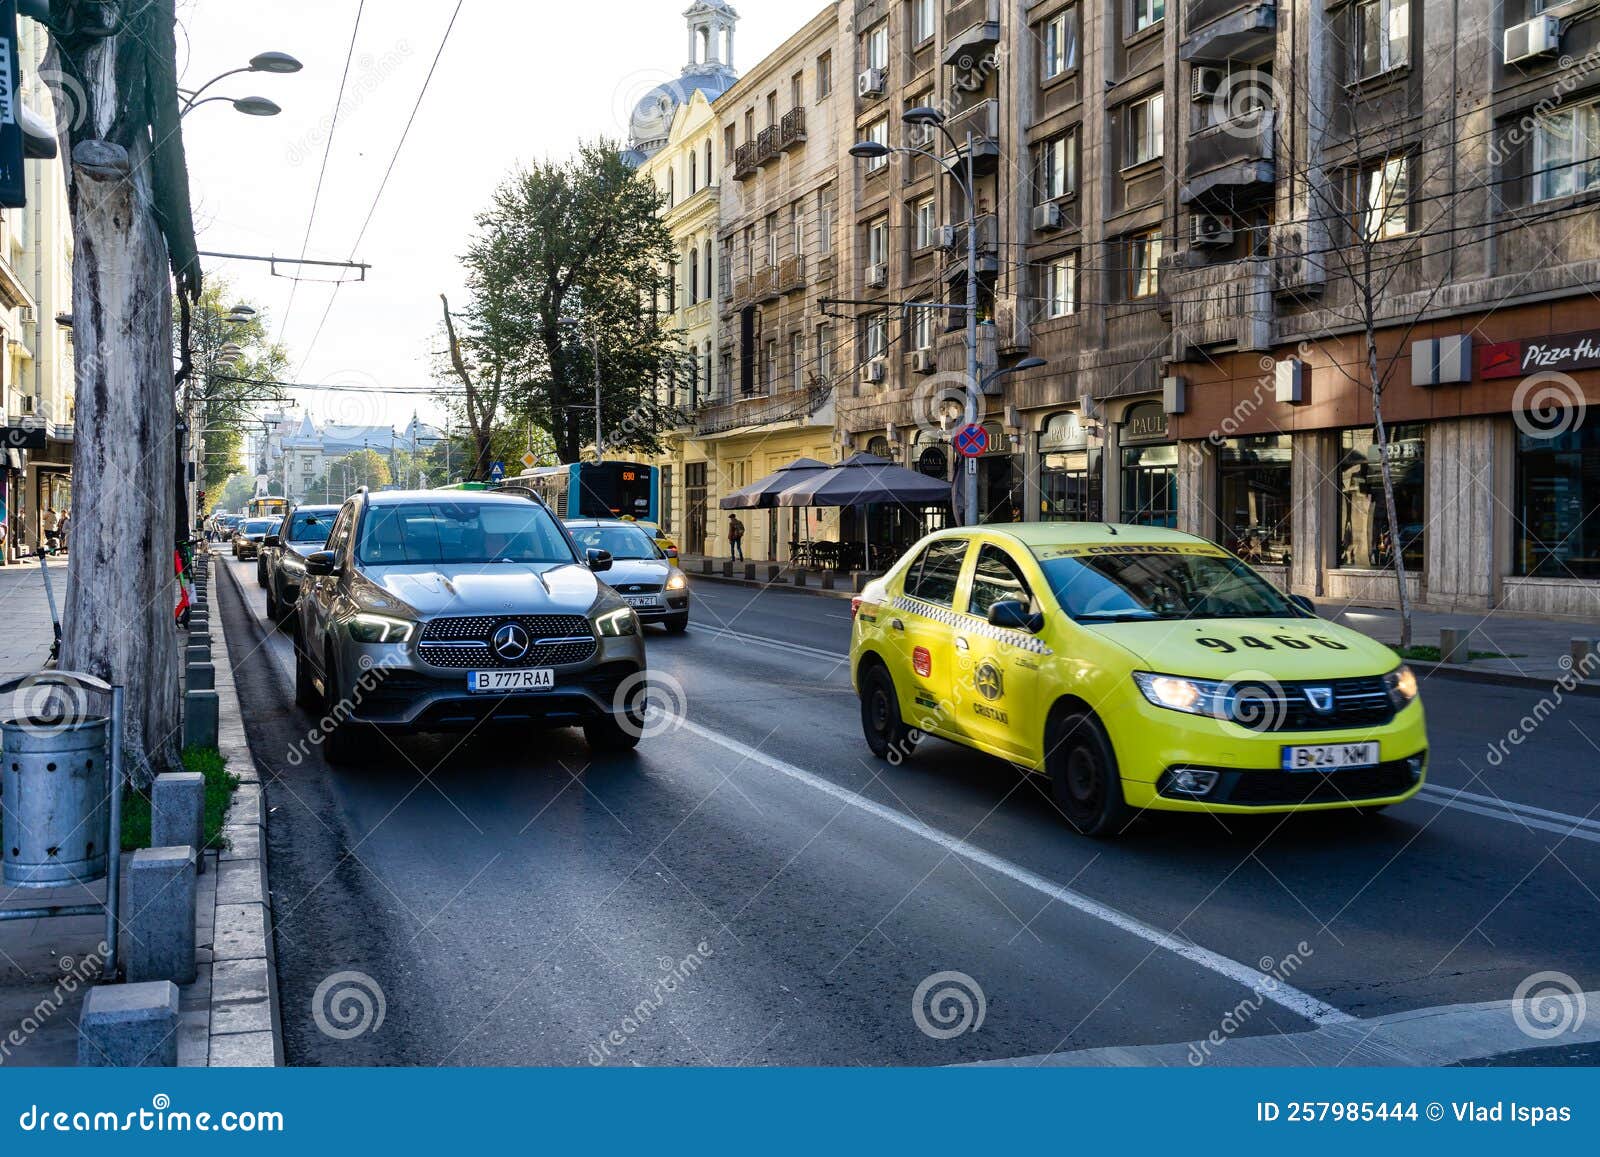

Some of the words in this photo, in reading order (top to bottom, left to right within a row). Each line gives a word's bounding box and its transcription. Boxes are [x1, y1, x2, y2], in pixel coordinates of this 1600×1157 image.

[1522, 345, 1571, 369] Pizza
[1573, 339, 1600, 361] Hu
[1051, 424, 1077, 441] PAUL
[1132, 416, 1164, 434] PAUL
[1087, 545, 1181, 554] CRISTAXI
[1196, 635, 1348, 653] 9466
[480, 673, 490, 688] B
[495, 672, 520, 687] 777
[523, 671, 550, 686] RAA
[973, 703, 1009, 725] CRISTAXI
[1296, 748, 1309, 767] B
